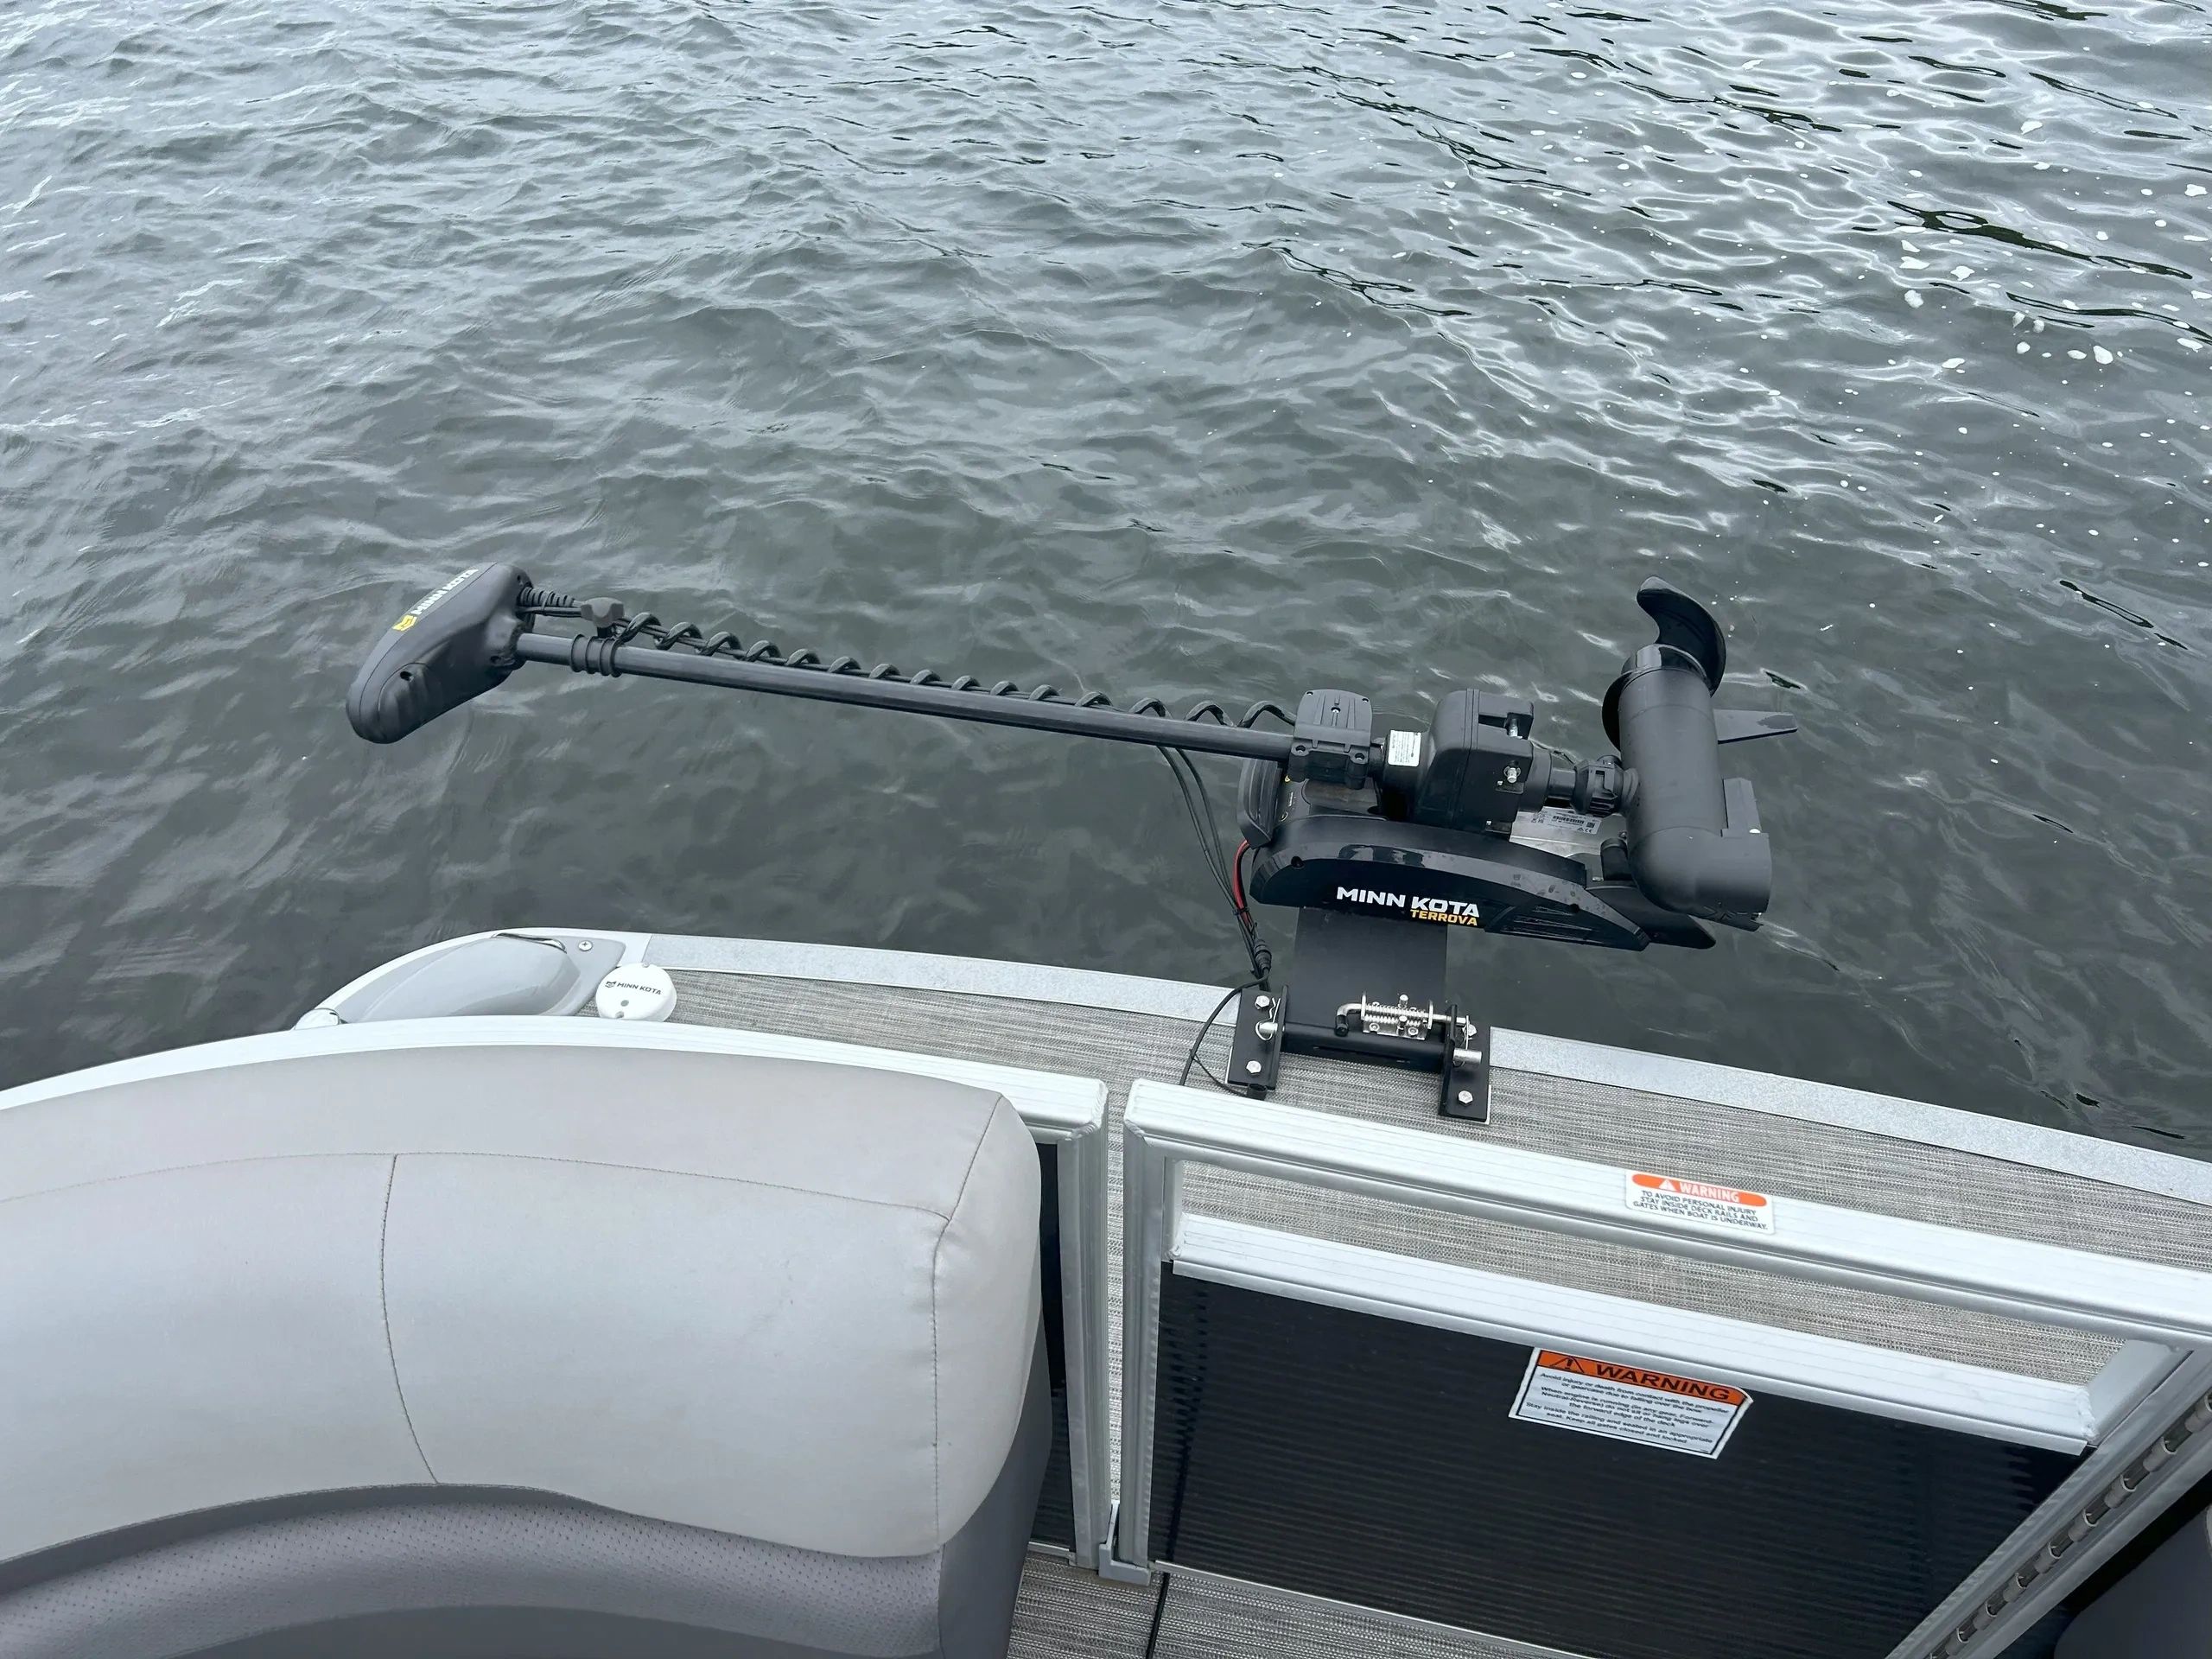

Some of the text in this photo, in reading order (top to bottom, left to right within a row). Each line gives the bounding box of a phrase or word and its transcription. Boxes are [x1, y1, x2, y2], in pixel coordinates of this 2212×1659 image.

[410, 589, 448, 615] MINN
[1336, 887, 1479, 918] MINN KOTA
[1410, 909, 1478, 926] TERROVA
[639, 986, 662, 995] KOTA
[1655, 1192, 1681, 1202] AVOID
[1682, 1198, 1726, 1211] PERSONAL
[1727, 1206, 1757, 1216] INJURY
[1679, 1181, 1740, 1204] WARNING
[1633, 1201, 1658, 1211] GATES
[1660, 1205, 1685, 1216] WHEN
[1687, 1211, 1708, 1220] BOAT
[1720, 1216, 1769, 1230] UNDERWAY.
[1641, 1196, 1758, 1222] STAY INSIDE DECK RAILS AND
[1596, 1363, 1730, 1400] WARNING
